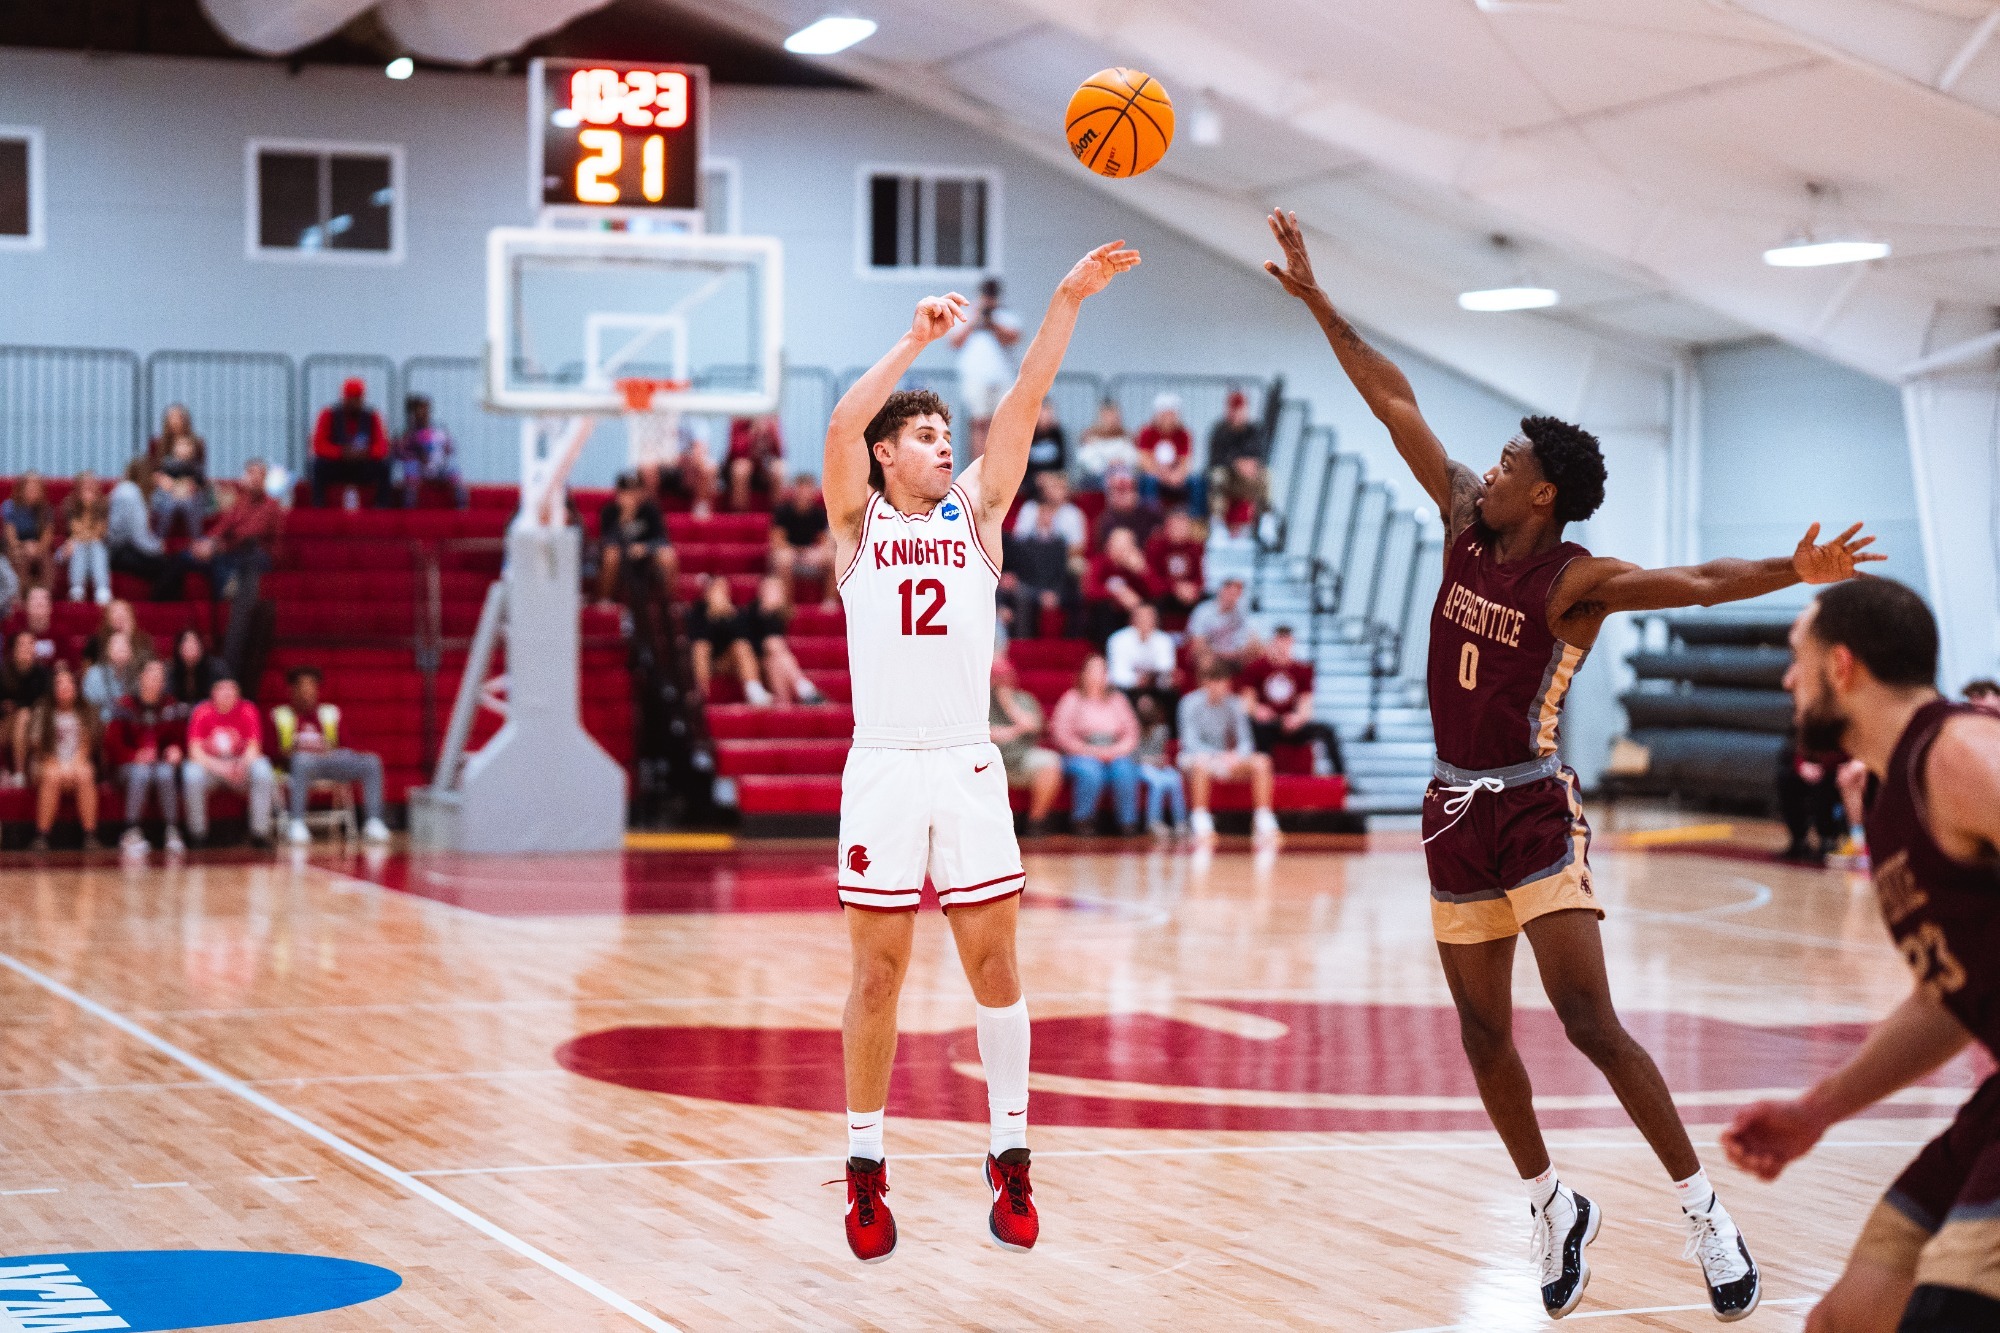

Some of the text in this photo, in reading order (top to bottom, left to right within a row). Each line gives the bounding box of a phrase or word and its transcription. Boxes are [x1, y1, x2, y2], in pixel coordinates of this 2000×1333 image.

[576, 129, 664, 203] 21
[873, 537, 967, 570] KNIGHTS
[898, 578, 948, 636] 12
[1442, 581, 1526, 648] APPRENTICE
[1458, 641, 1480, 691] 0
